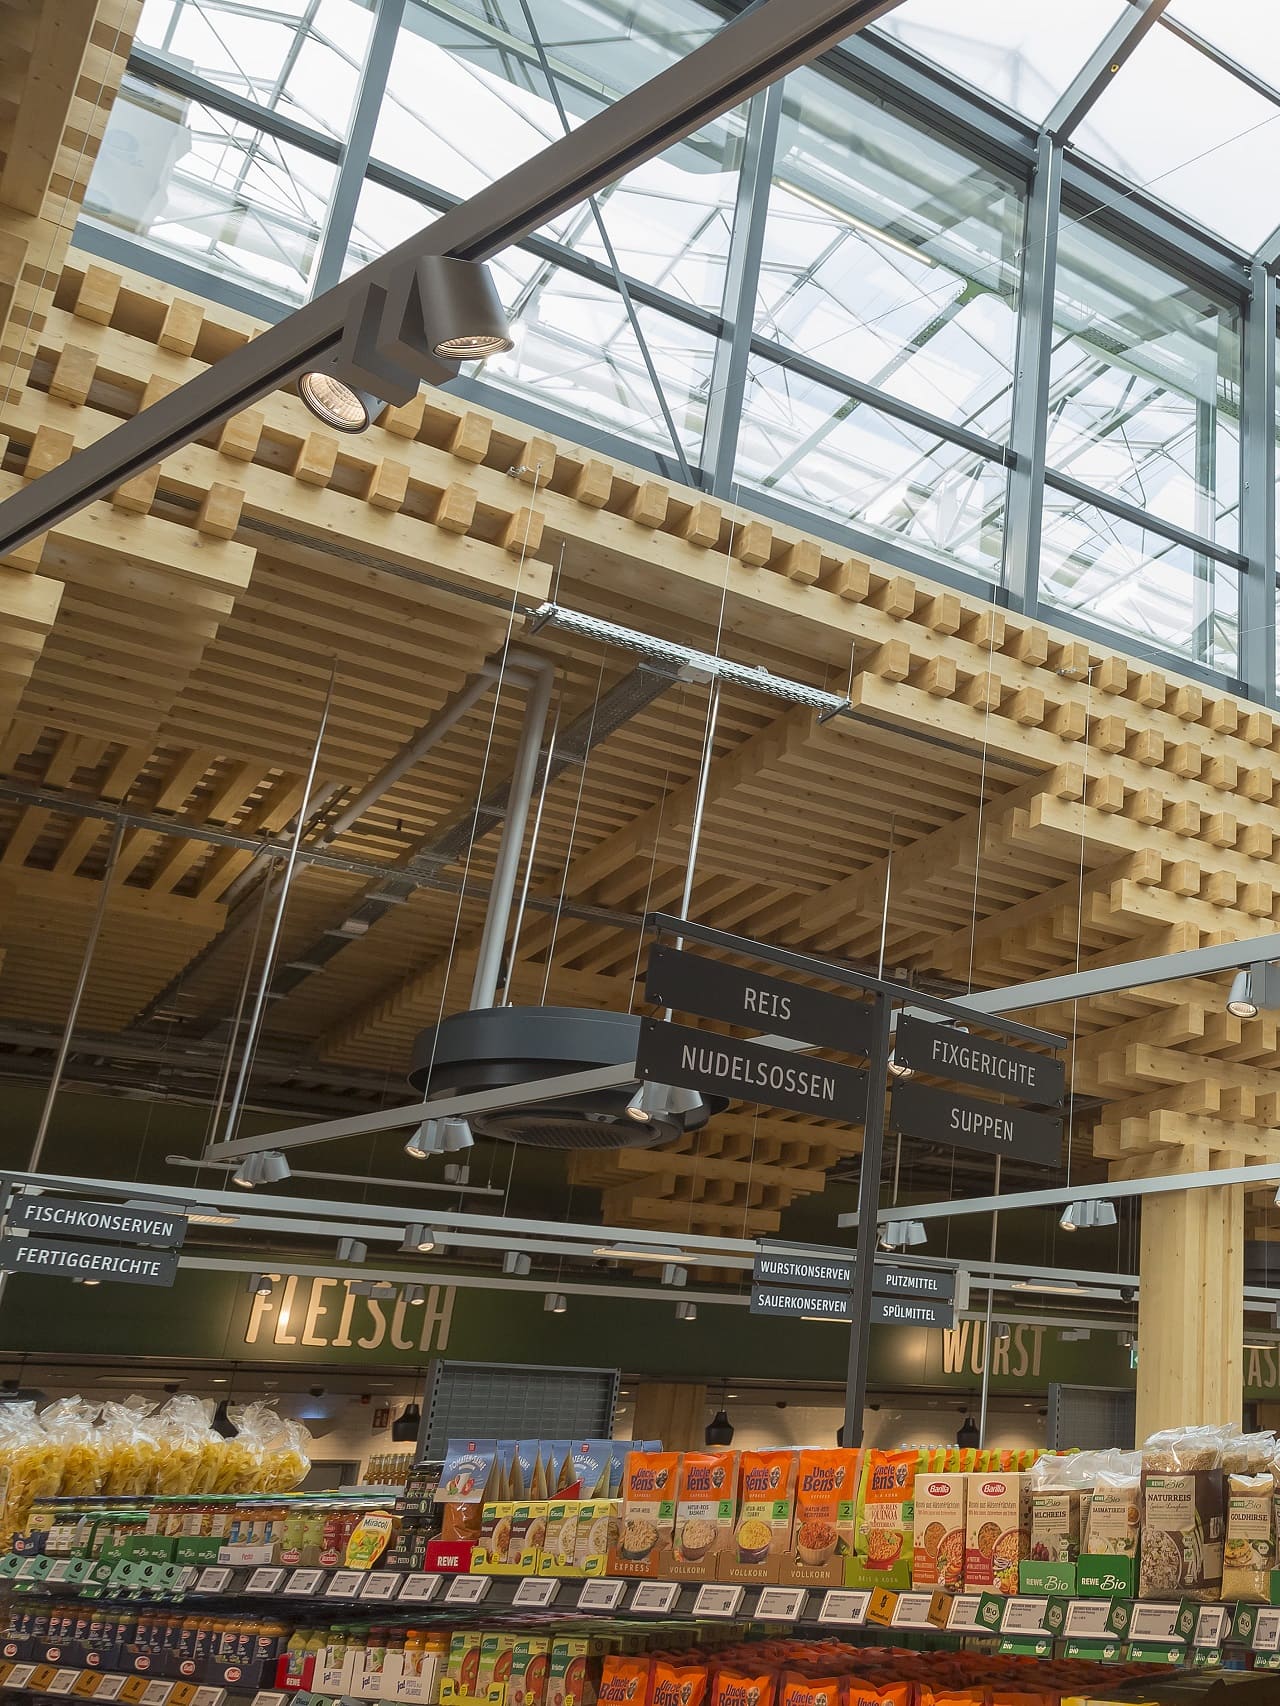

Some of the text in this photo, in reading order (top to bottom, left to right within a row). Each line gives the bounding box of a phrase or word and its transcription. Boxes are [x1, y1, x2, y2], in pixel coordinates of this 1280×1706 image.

[743, 987, 792, 1020] REIS
[931, 1039, 1037, 1088] FIXGERICHTE
[681, 1044, 836, 1101] NUDELSOSSEN
[949, 1107, 1015, 1142] SUPPEN
[24, 1205, 174, 1237] FISCHKONSERVEN
[16, 1247, 161, 1276] FERTIGGERICHTE
[760, 1260, 850, 1281] WURSTKONSERVEN
[885, 1274, 938, 1291] PUTZMITTEL
[758, 1294, 847, 1313] SAUERKONSERVEN
[244, 1274, 457, 1352] FLEISCH
[882, 1304, 936, 1321] SPÜLMITTEL
[943, 1320, 1047, 1377] WURST
[930, 1484, 949, 1493] Barilla
[984, 1484, 1005, 1493] Barilla
[1148, 1494, 1191, 1502] NATURREIS
[665, 1505, 671, 1514] 2
[723, 1504, 729, 1513] 2
[778, 1505, 784, 1514] 2
[844, 1506, 850, 1514] 2
[908, 1506, 914, 1514] 2
[1034, 1511, 1066, 1519] MILCHREIS
[1231, 1513, 1268, 1521] GOLDHIRSE
[363, 1518, 388, 1531] Miracoli
[437, 1555, 459, 1567] REWE
[614, 1562, 650, 1573] EXPRESS
[669, 1566, 706, 1575] VOLLKORN
[729, 1568, 768, 1577] VOLLKORN
[790, 1570, 831, 1579] VOLLKORN
[1044, 1575, 1068, 1591] Bio
[1081, 1574, 1127, 1591] REWE Bio
